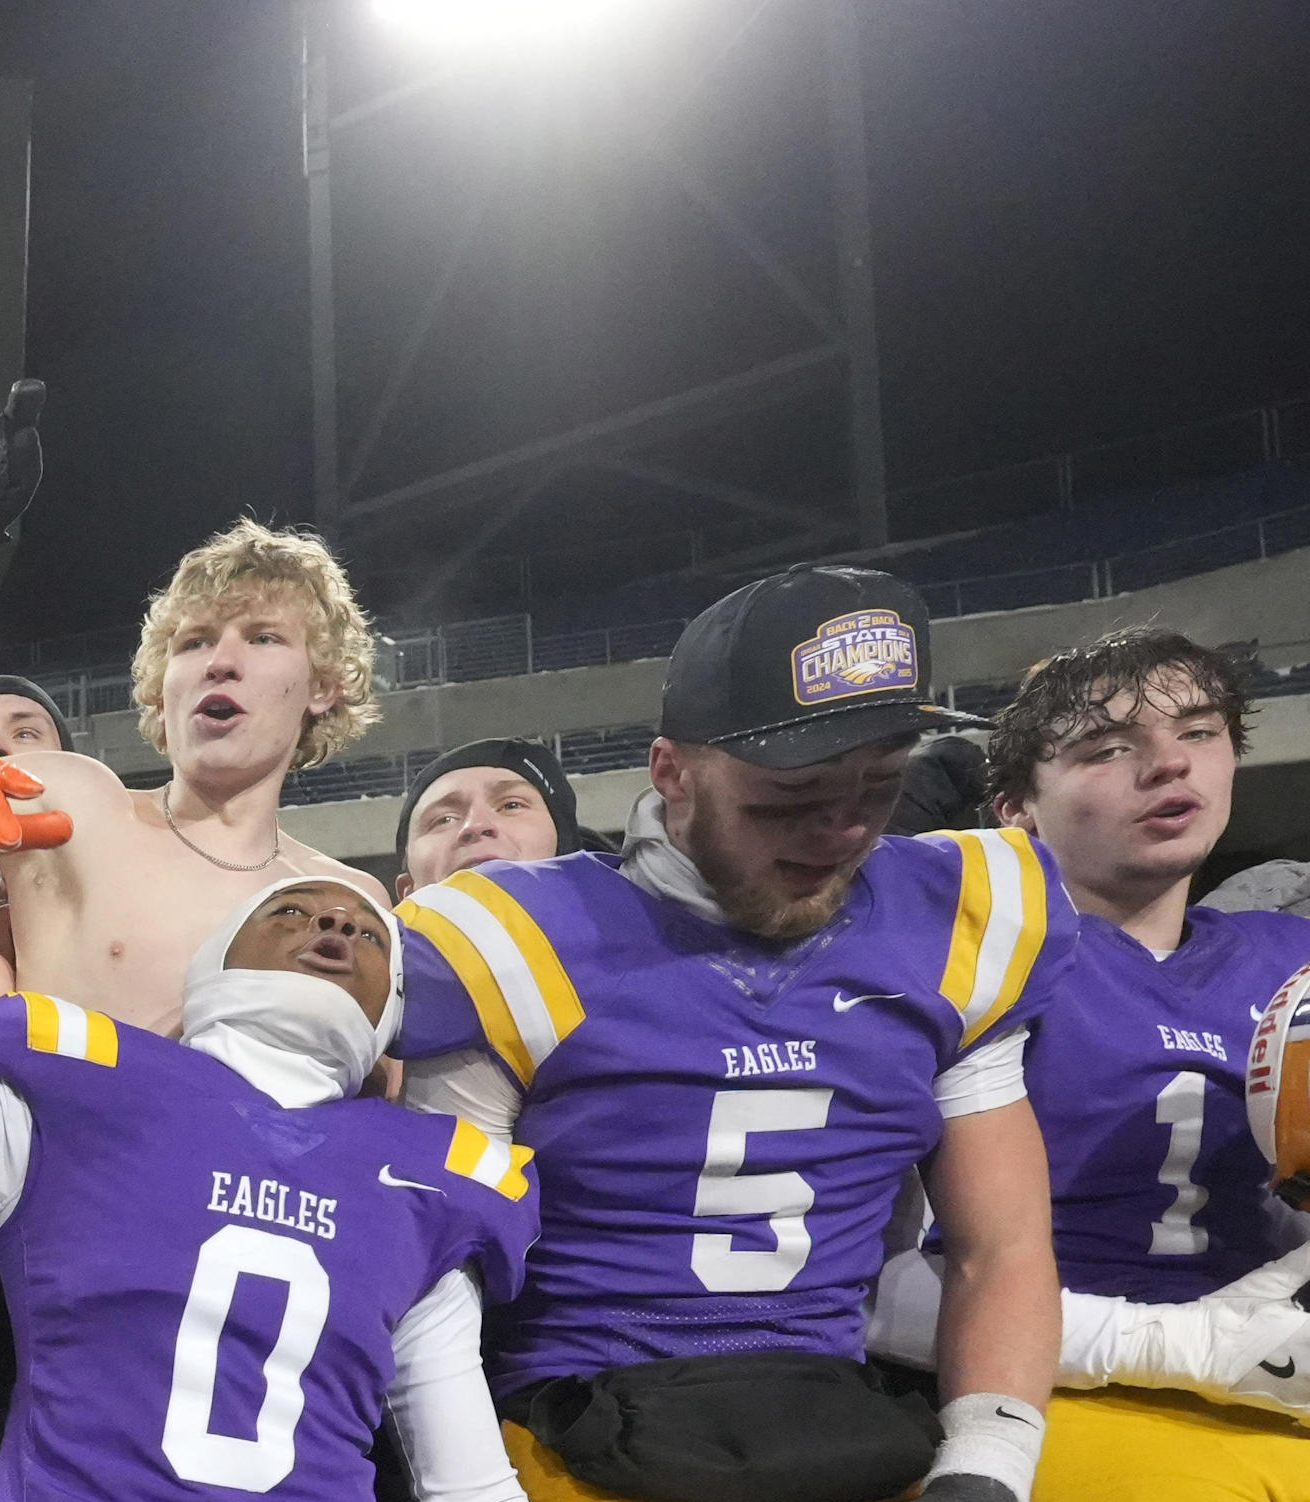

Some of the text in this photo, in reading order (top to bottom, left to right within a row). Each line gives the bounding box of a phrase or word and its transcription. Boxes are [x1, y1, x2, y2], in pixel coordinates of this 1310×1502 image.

[821, 628, 898, 649] STATE
[827, 621, 856, 636] BACK
[858, 615, 872, 629] 2
[801, 640, 913, 683] CHAMPIONS
[806, 681, 831, 694] 2024
[721, 1041, 817, 1078] EAGLES
[1156, 1025, 1228, 1062] EAGLES
[1148, 1072, 1210, 1255] 1
[207, 1171, 337, 1240] EAGLES
[690, 1089, 834, 1293] 5
[161, 1224, 330, 1494] 0
